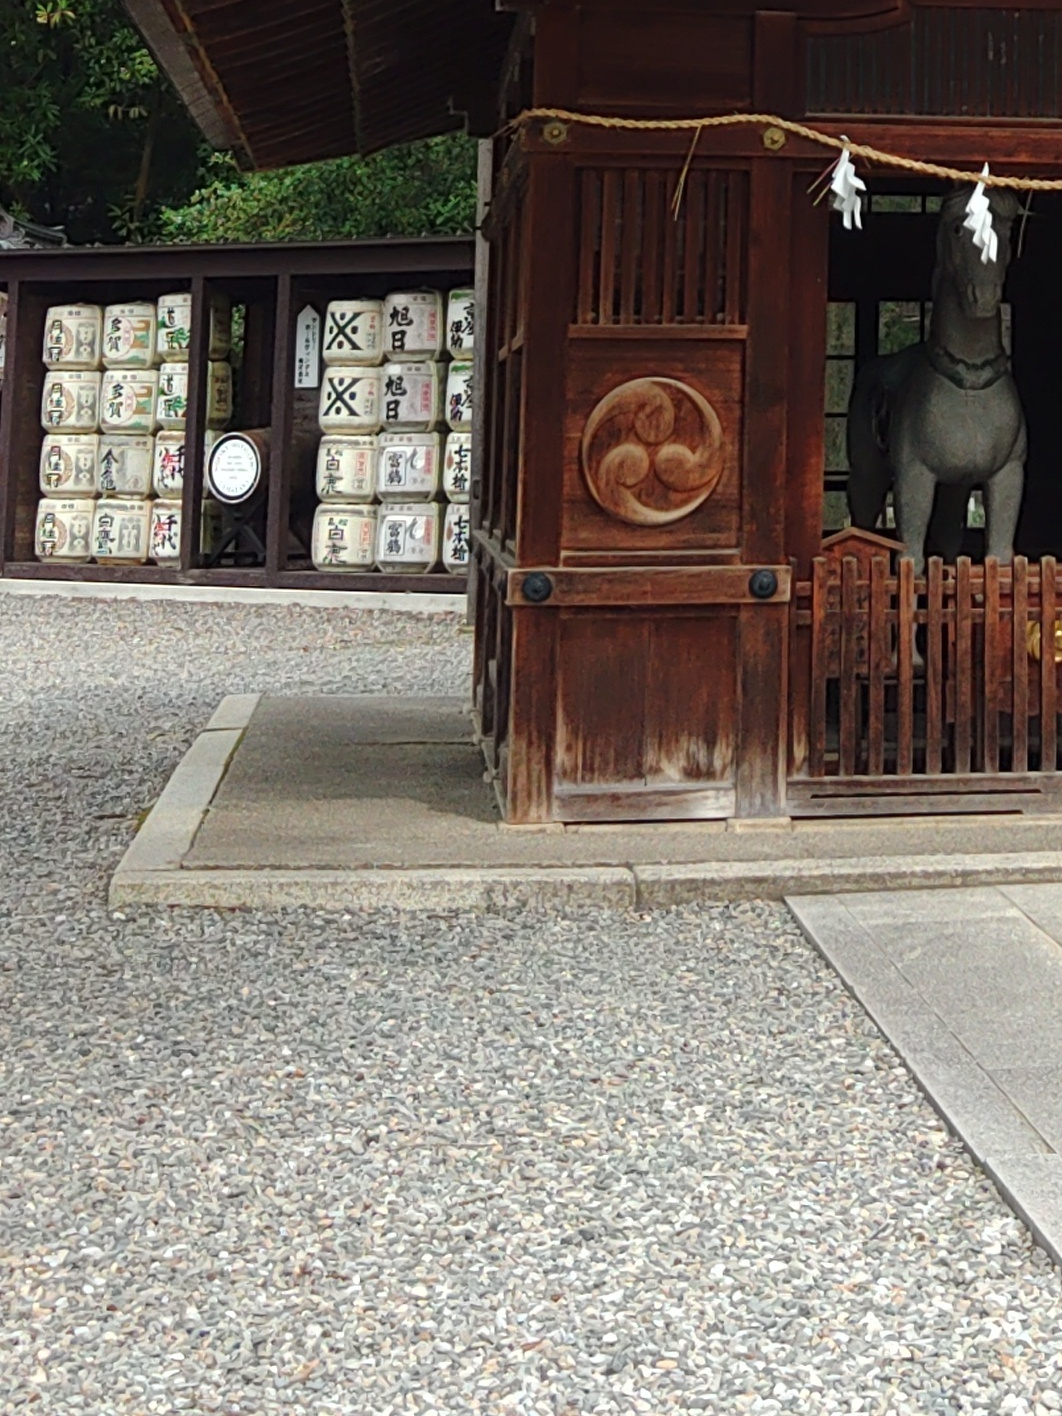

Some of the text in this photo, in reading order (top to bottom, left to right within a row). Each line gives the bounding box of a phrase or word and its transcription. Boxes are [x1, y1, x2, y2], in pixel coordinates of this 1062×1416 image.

[107, 317, 122, 352] 多賀
[389, 305, 414, 351] 旭日
[108, 383, 123, 418] 多賀
[384, 375, 408, 420] 旭日
